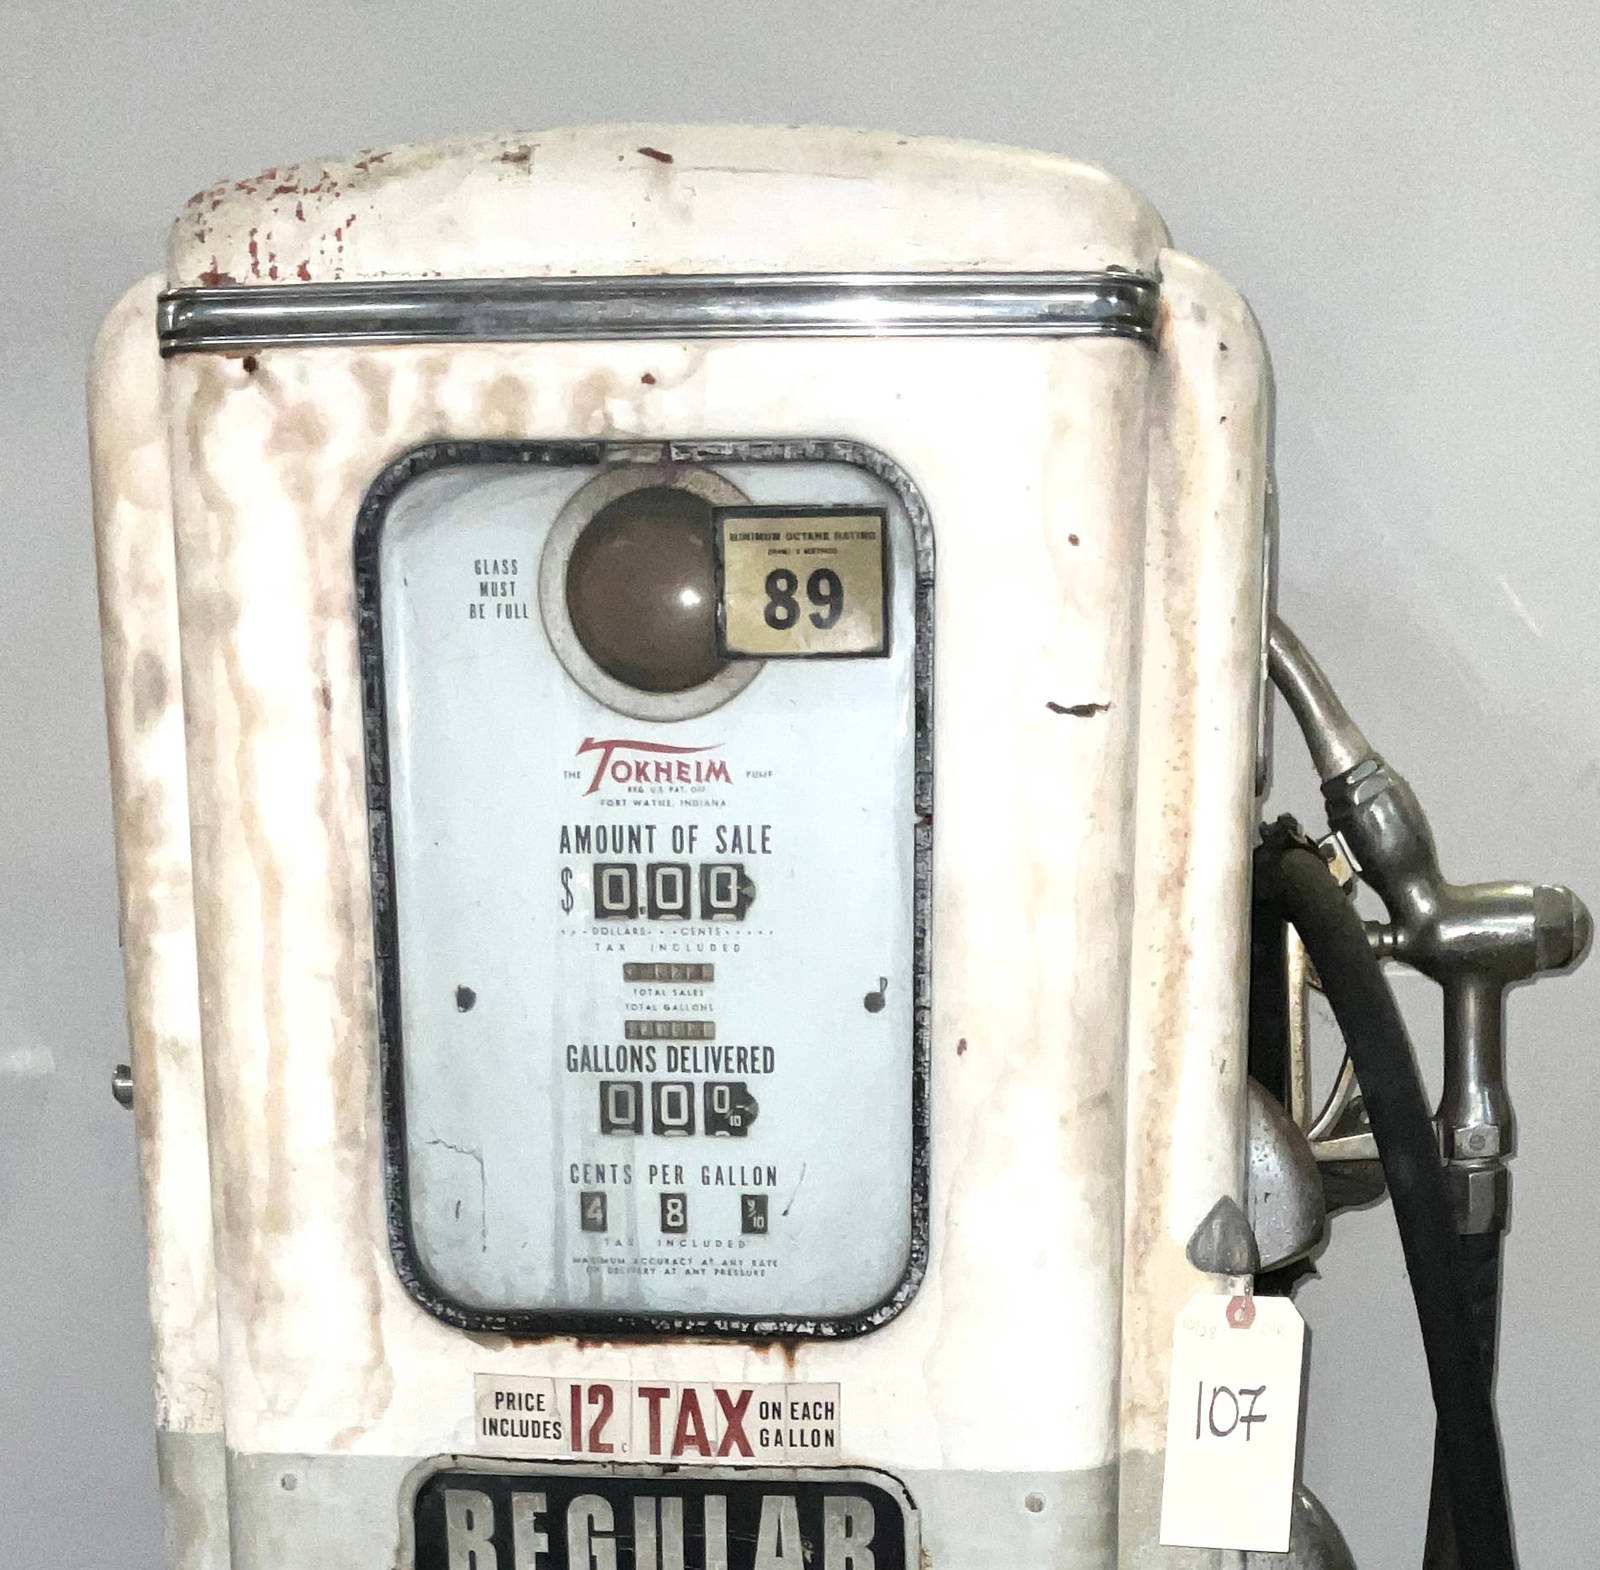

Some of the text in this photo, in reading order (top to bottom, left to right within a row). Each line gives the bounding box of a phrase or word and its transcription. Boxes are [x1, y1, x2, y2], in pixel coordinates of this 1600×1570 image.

[785, 531, 831, 541] OCTANE
[834, 531, 877, 541] RATING
[474, 559, 519, 576] GLASS
[480, 581, 516, 597] MUST
[763, 567, 845, 631] 89
[469, 603, 529, 619] BE FULL
[563, 770, 582, 780] THE
[575, 737, 733, 797] TOKHEIM
[599, 798, 628, 808] FORT
[679, 798, 727, 808] INDIANA
[559, 824, 773, 855] AMOUNT OF SALE
[591, 926, 722, 936] DOLLARS CENTS
[594, 942, 742, 953] TAX INCLUDED
[632, 988, 705, 997] TOTAL SALES
[624, 1002, 715, 1012] TOTAL GALLONS
[565, 1044, 776, 1075] GALLONS DELIVERED
[569, 1163, 778, 1187] CENTS PER GALLON
[586, 1197, 604, 1223] 4
[665, 1197, 685, 1228] 8
[657, 1239, 747, 1250] INCLUDED
[494, 1390, 547, 1413] PRICE
[759, 1400, 835, 1421] ON EACH
[1195, 1380, 1268, 1442] 107
[482, 1417, 563, 1441] INCLUDES
[570, 1383, 615, 1454] 12
[637, 1386, 756, 1458] TAX
[759, 1428, 835, 1448] GALLON
